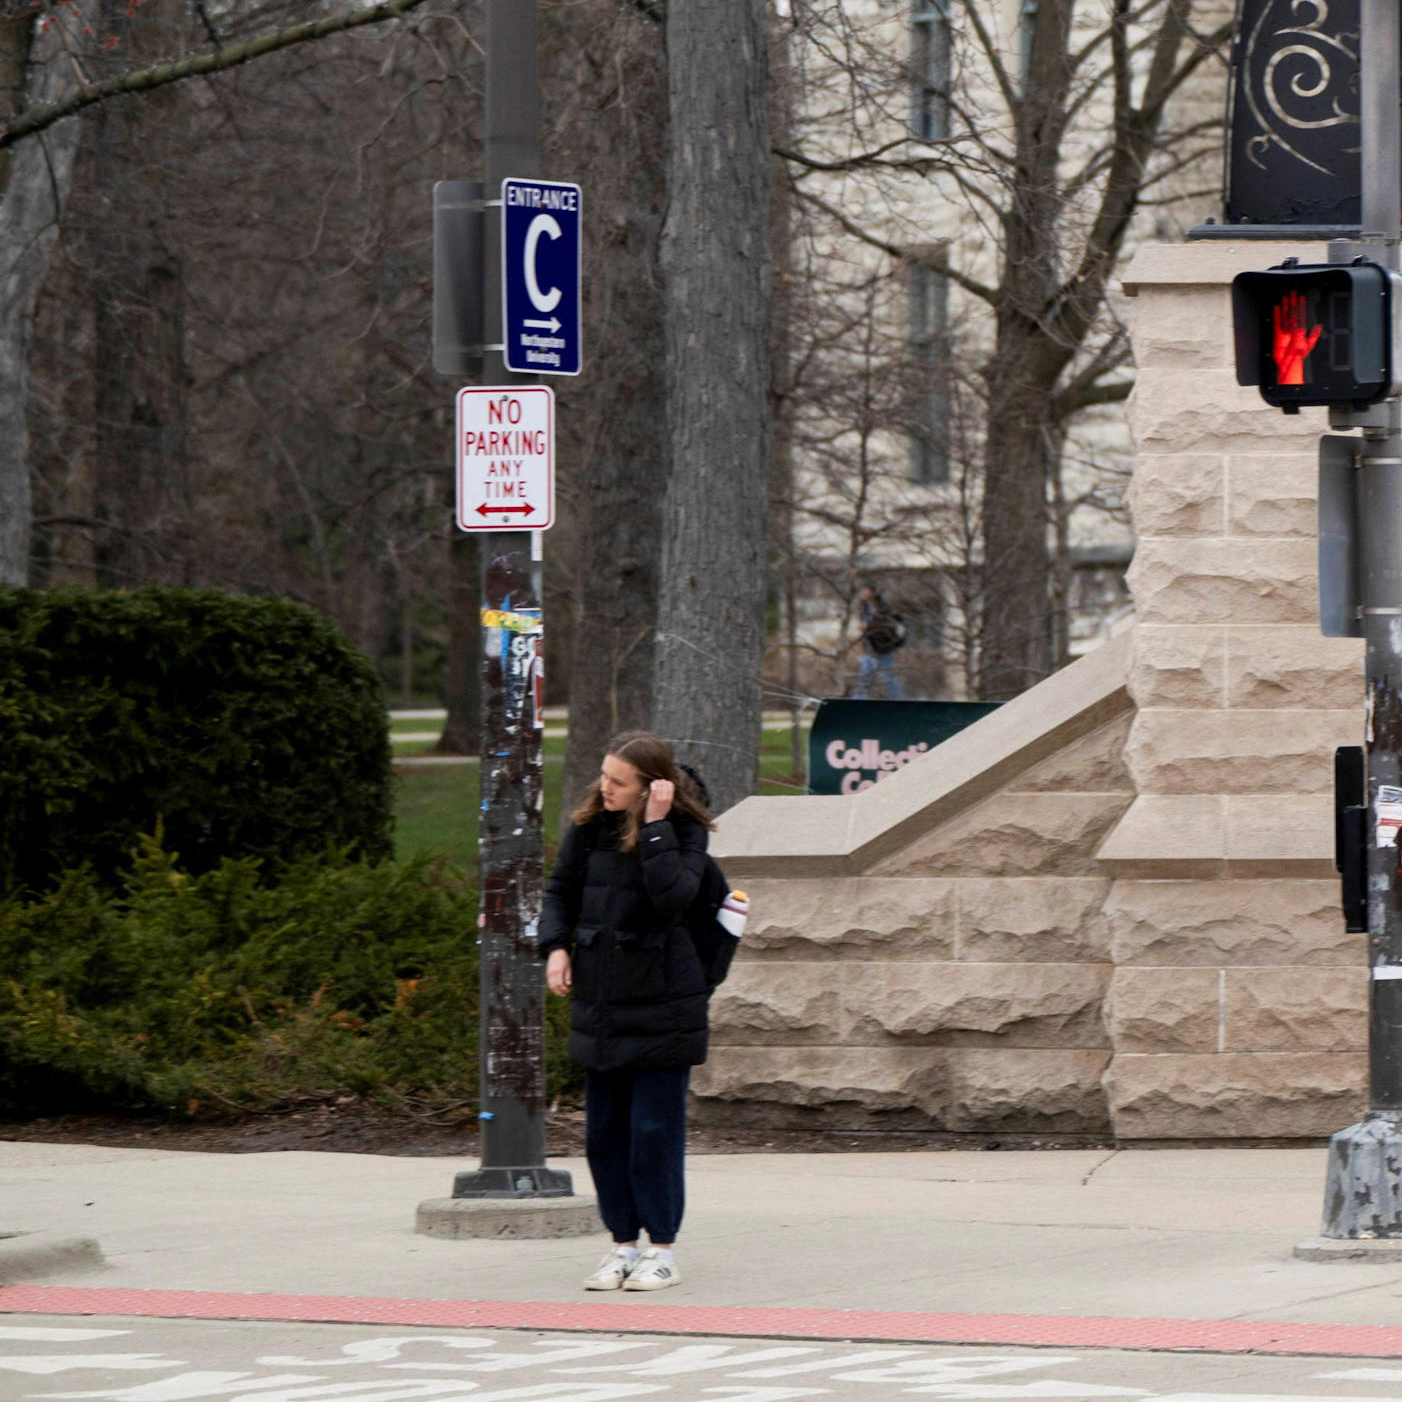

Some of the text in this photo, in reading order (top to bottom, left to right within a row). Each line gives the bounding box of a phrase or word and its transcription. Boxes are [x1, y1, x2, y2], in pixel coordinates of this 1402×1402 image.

[507, 186, 577, 211] ENTRANCE
[523, 213, 562, 313] C
[488, 399, 522, 424] NO
[465, 430, 545, 456] PARKING
[487, 460, 523, 477] ANY
[484, 481, 527, 498] TIME
[254, 1335, 1081, 1384] BIKES
